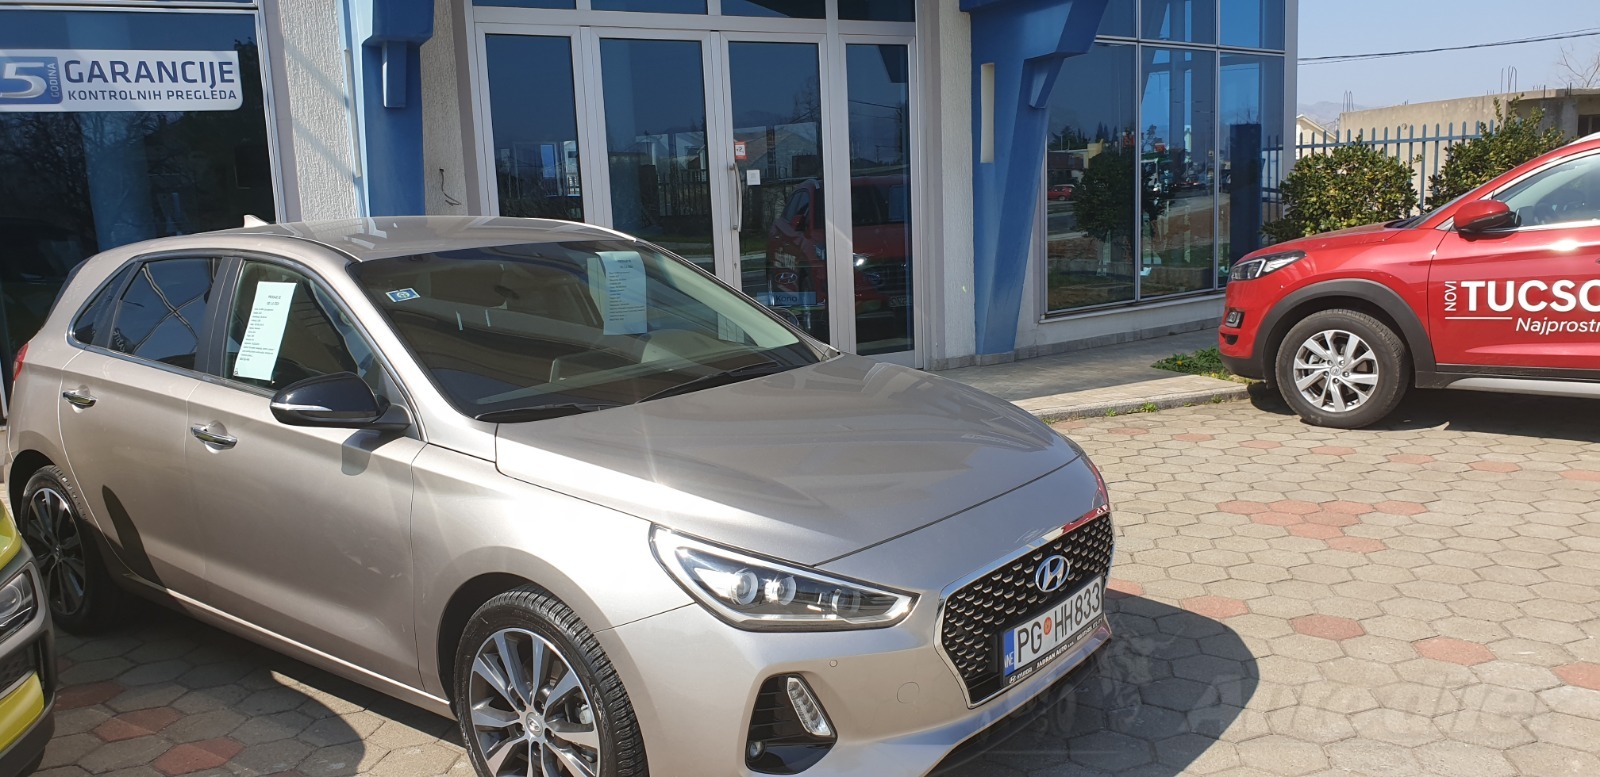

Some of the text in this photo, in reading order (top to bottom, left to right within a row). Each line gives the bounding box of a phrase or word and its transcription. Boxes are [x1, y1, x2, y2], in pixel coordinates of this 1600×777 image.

[0, 62, 47, 99] 5
[64, 60, 235, 89] GARANCIJE
[68, 89, 237, 100] KONTROLNIH PREGLEDA
[1444, 281, 1457, 311] NOVI
[1017, 621, 1042, 663] PG
[1054, 582, 1101, 642] HH833
